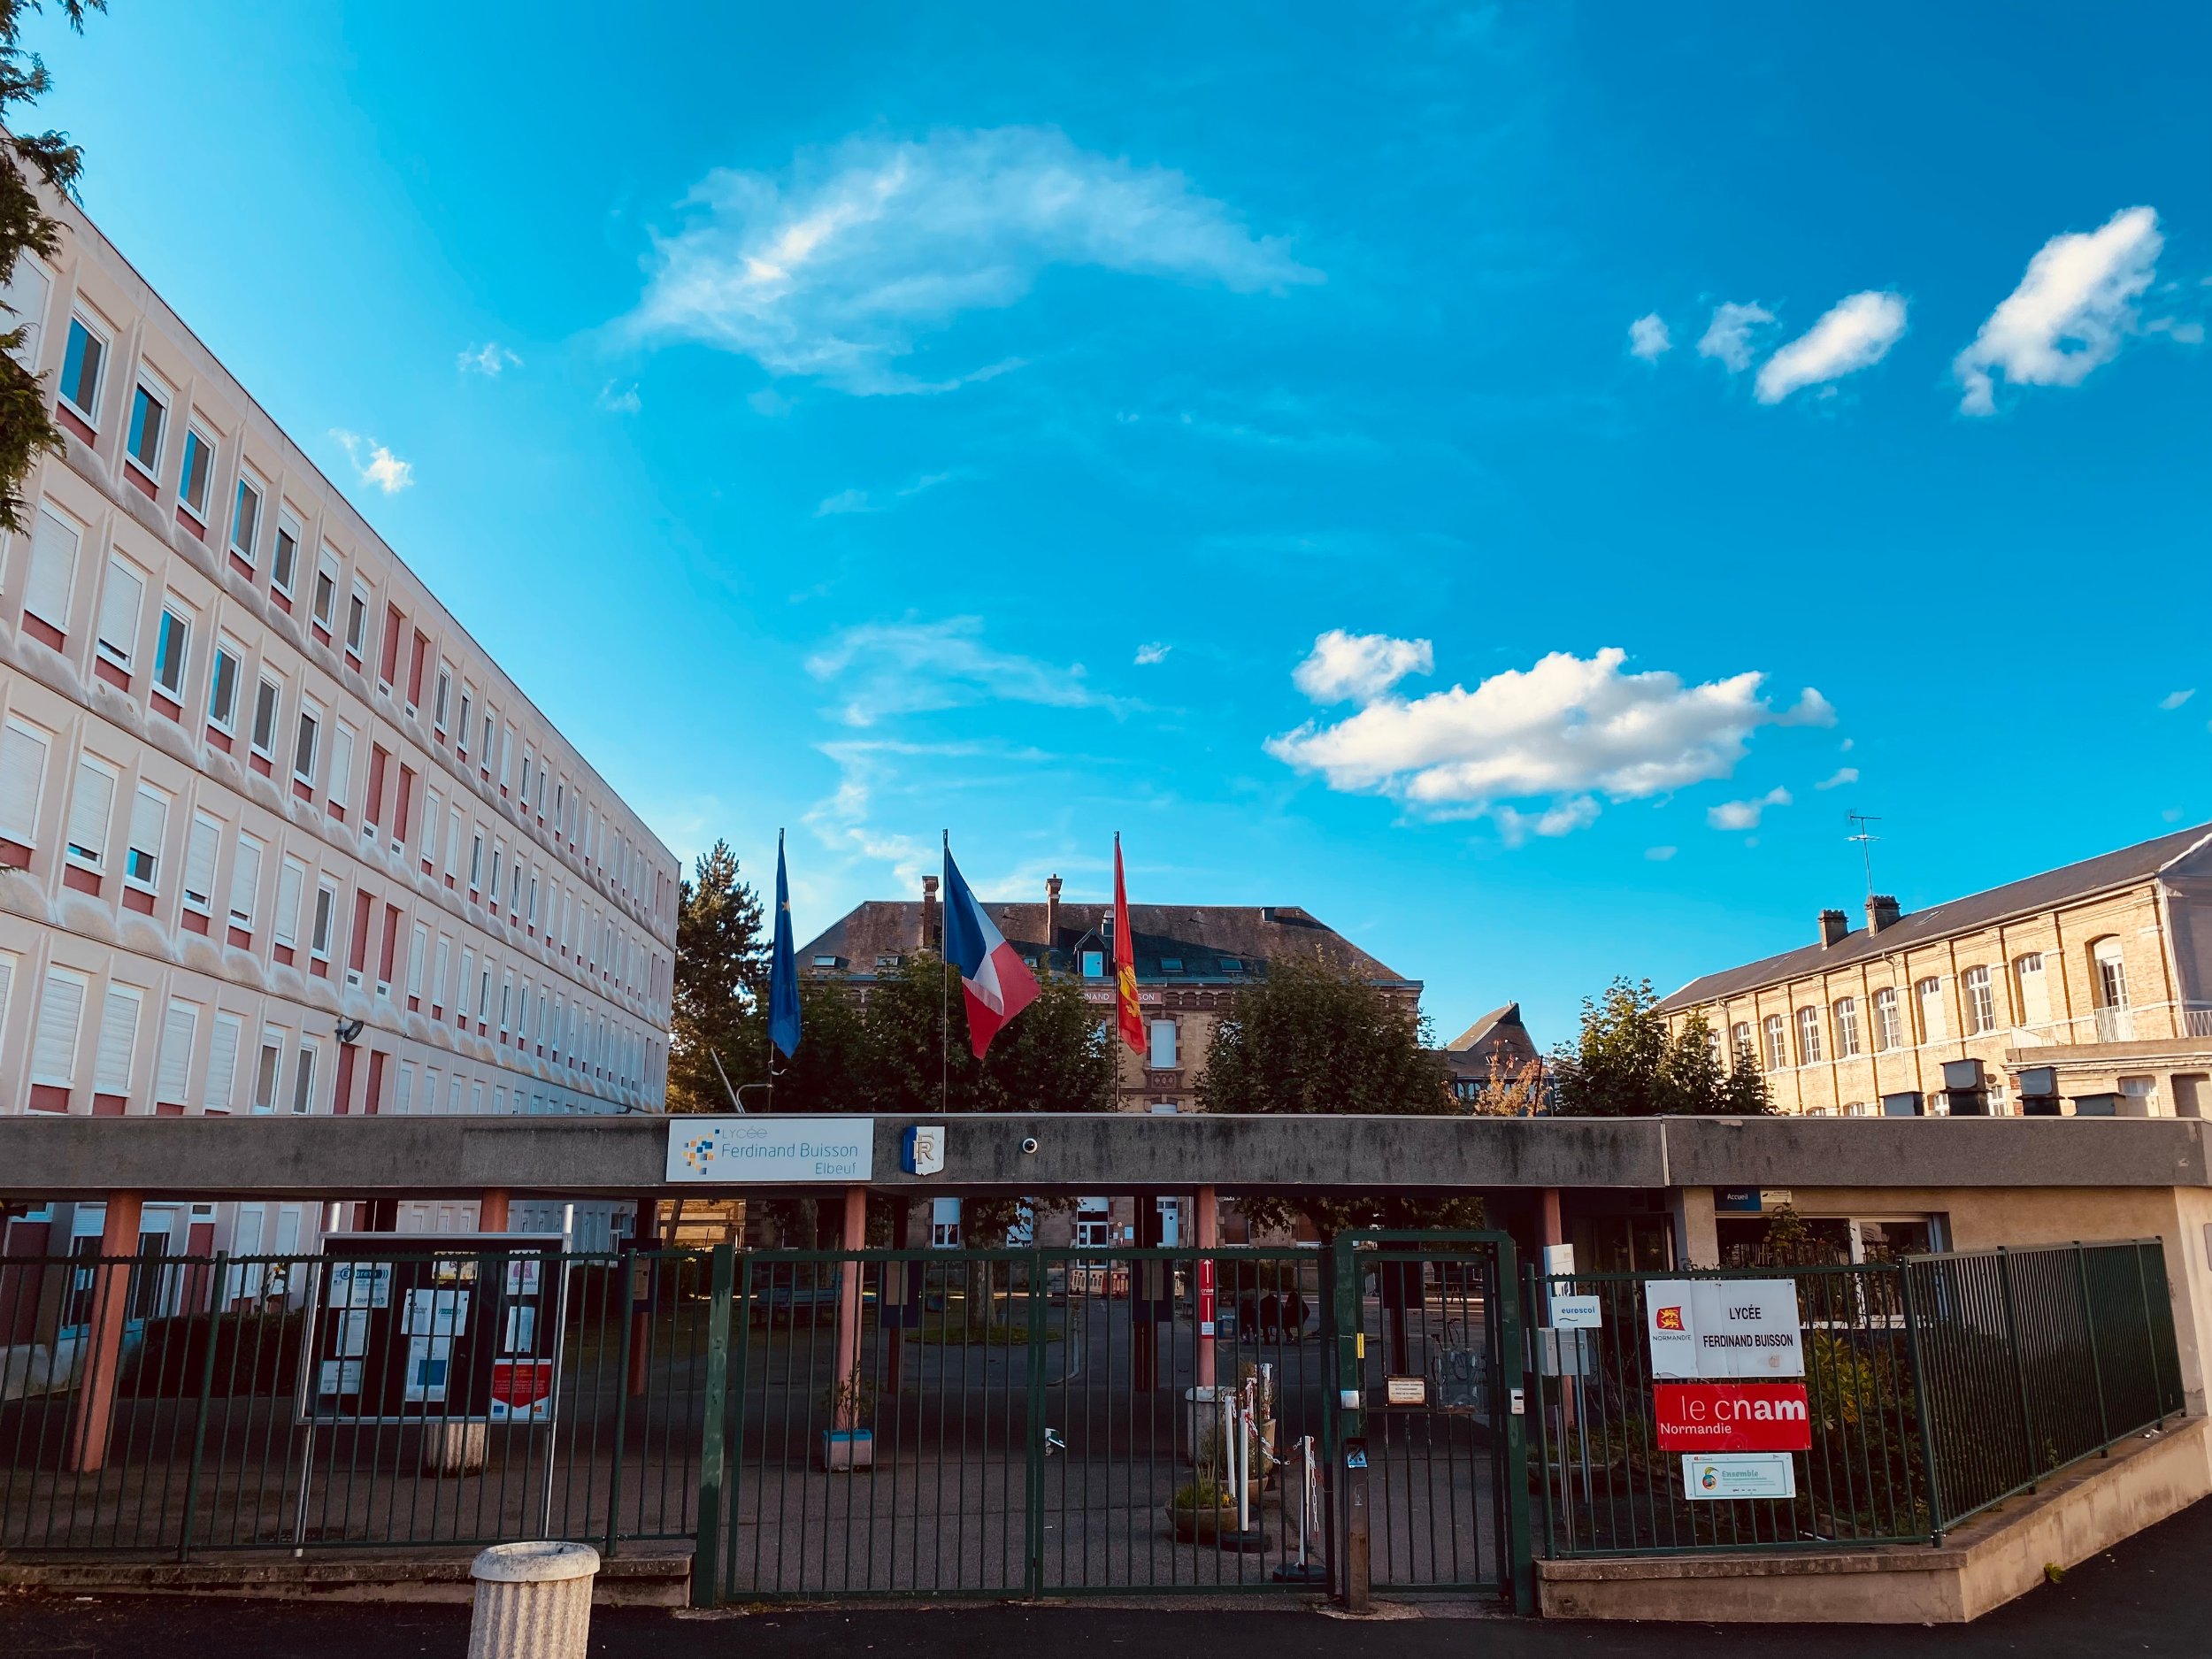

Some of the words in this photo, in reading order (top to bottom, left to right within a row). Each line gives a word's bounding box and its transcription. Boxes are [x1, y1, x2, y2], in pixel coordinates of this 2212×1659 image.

[721, 1142, 795, 1158] Ferdinand
[800, 1142, 858, 1158] Buisson
[815, 1162, 856, 1175] Elbeuf
[1729, 1304, 1762, 1320] LYCÉE
[1703, 1334, 1753, 1348] FERDINAND
[1755, 1333, 1793, 1347] BUISSON
[1681, 1395, 1706, 1421] le
[1715, 1399, 1806, 1421] cnam
[1660, 1423, 1732, 1435] Normandie
[1722, 1469, 1759, 1478] Ensemble
